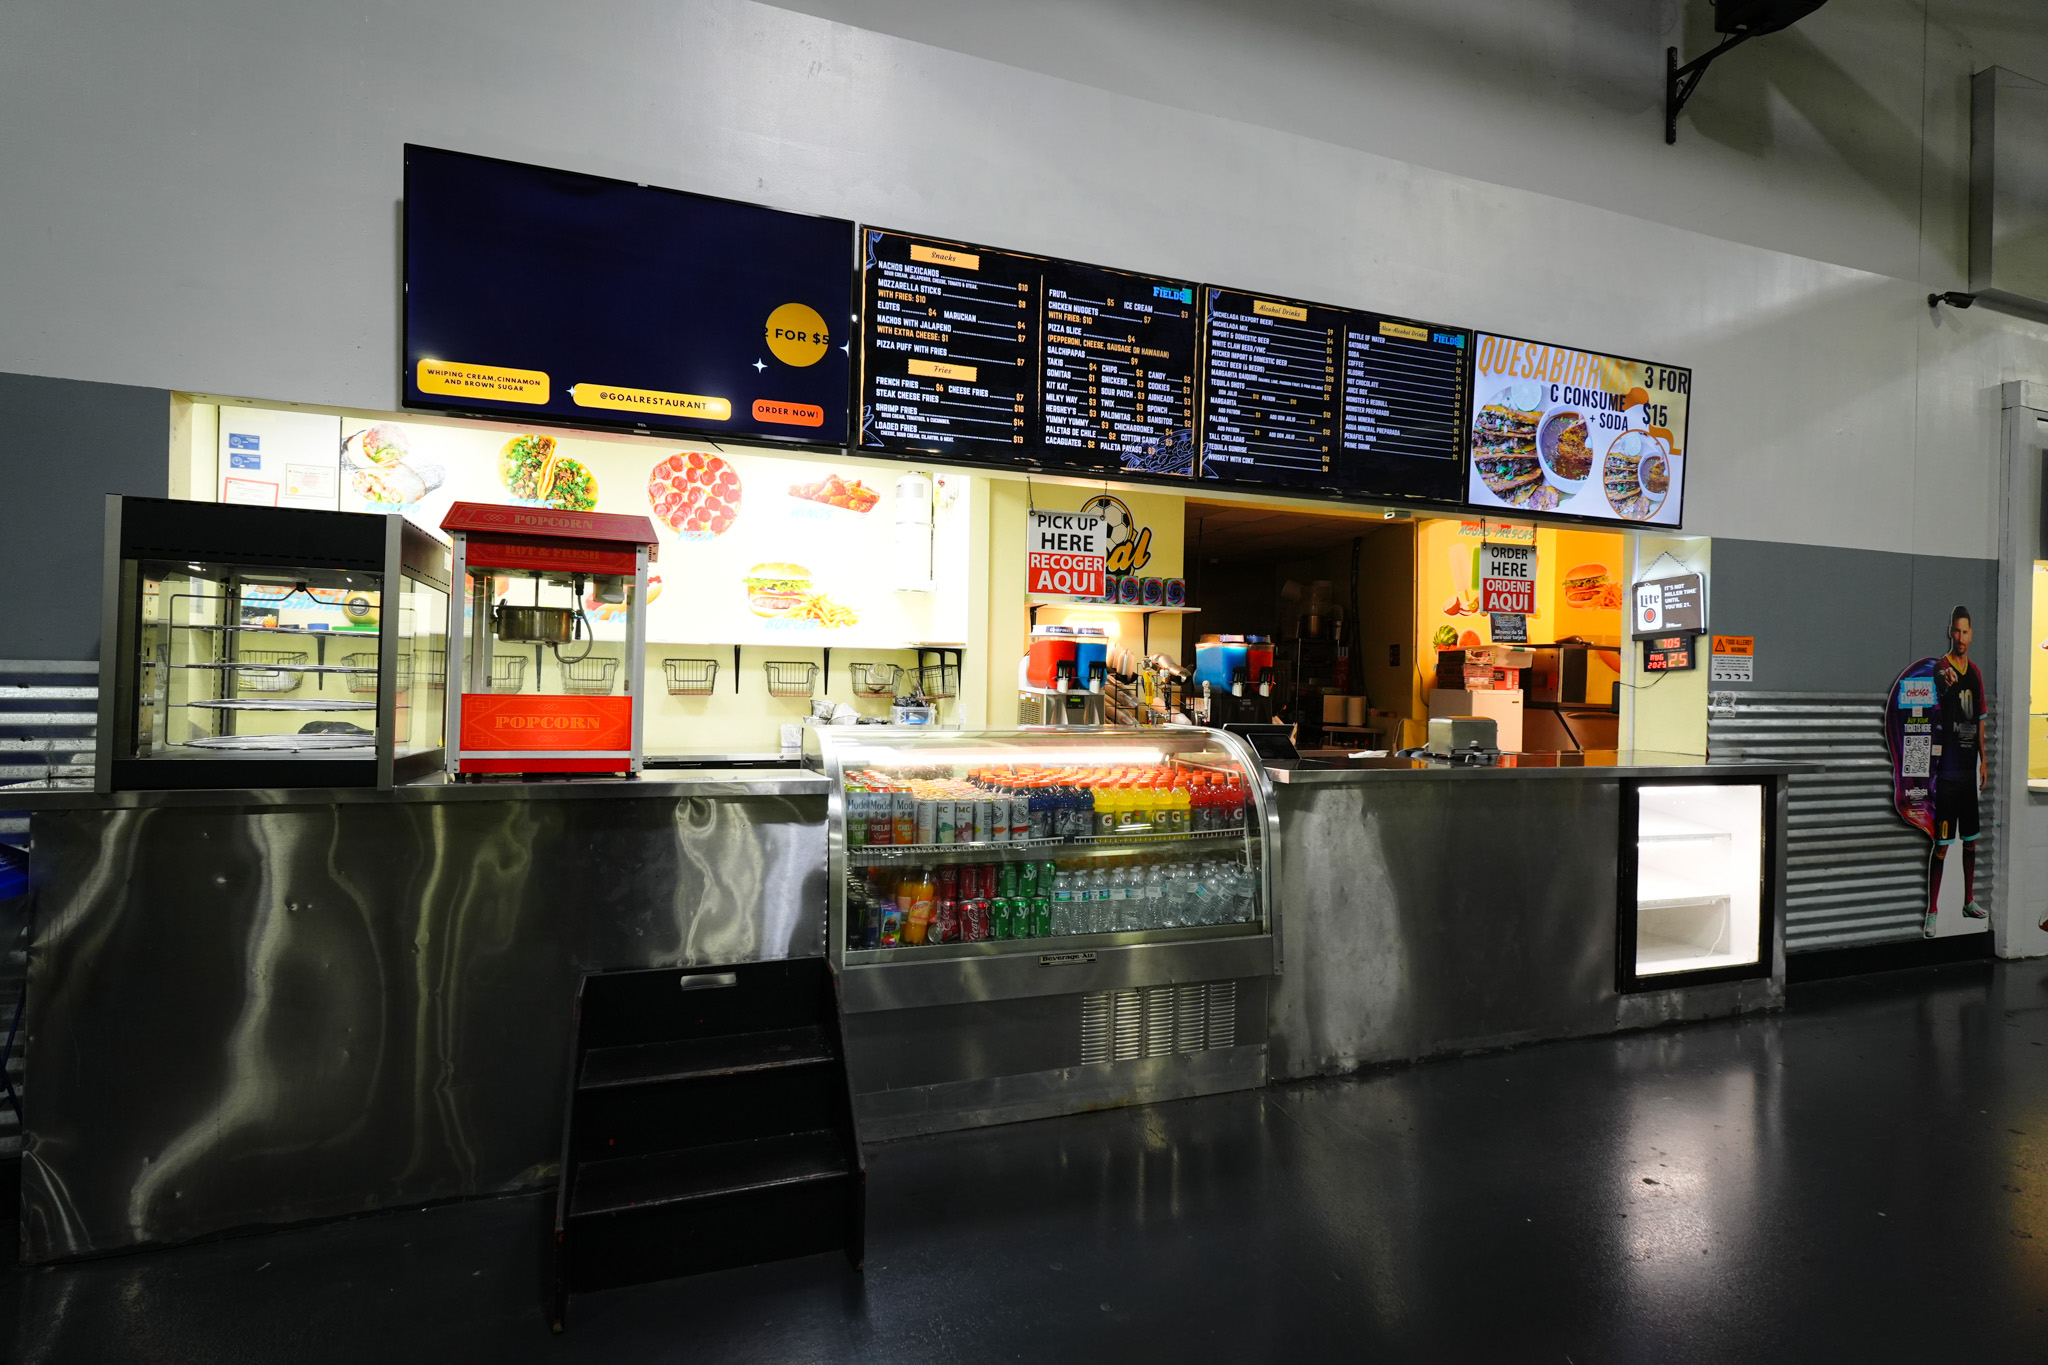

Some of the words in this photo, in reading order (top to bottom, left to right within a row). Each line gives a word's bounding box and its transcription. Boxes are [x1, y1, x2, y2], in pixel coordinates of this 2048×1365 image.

[932, 252, 956, 262] Snacks
[879, 261, 902, 272] NACHOS
[905, 265, 939, 277] MEXICANOS
[1018, 283, 1028, 292] $10
[878, 279, 919, 292] MOZZARELLA
[921, 285, 941, 295] STICKS
[1153, 286, 1186, 301] FIELDS
[878, 289, 893, 299] WITH
[895, 291, 914, 302] FRIES:
[916, 294, 926, 303] $10
[1049, 289, 1067, 299] FRUTA
[1107, 298, 1114, 306] $5
[878, 301, 900, 311] ELOTES
[928, 308, 937, 317] $4
[1049, 301, 1072, 312] CHICKEN
[1074, 305, 1098, 316] NUGGETS
[1144, 316, 1151, 324] $7
[1124, 301, 1133, 310] ICE
[1134, 303, 1153, 313] CREAM
[1259, 305, 1280, 314] Alcohol
[1282, 308, 1300, 318] Drinks
[944, 311, 976, 322] MARUCHAN
[1018, 321, 1025, 329] $4
[877, 315, 901, 325] NACHOS
[903, 318, 918, 328] WITH
[920, 321, 951, 332] JALAPENO
[1018, 335, 1025, 343] $7
[877, 325, 892, 335] WITH
[894, 328, 914, 338] EXTRA
[916, 330, 940, 341] CHEESE:
[942, 333, 948, 342] $1
[1048, 324, 1064, 333] PIZZA
[1066, 326, 1082, 336] SLICE
[1128, 335, 1135, 343] $4
[776, 329, 806, 342] FOR
[813, 333, 829, 345] $5
[1434, 333, 1459, 345] FIELDS
[877, 339, 895, 350] PIZZA
[897, 342, 912, 351] PUFF
[914, 344, 929, 354] WITH
[930, 346, 947, 356] FRIES
[1017, 358, 1025, 366] $7
[1048, 346, 1085, 358] SALCHIPAPAS
[934, 365, 952, 374] Fries
[1047, 357, 1063, 367] TAKIS
[1102, 364, 1117, 374] CHIPS
[1478, 336, 1636, 394] QUESABIRRIAS
[427, 369, 463, 377] WHIPING
[1148, 371, 1166, 381] CANDY
[1645, 367, 1653, 388] 3
[1659, 370, 1688, 394] FOR
[876, 376, 899, 387] FRENCH
[901, 379, 918, 389] FRIES
[936, 384, 944, 392] $6
[1101, 376, 1127, 386] SNICKERS
[1148, 382, 1170, 392] COOKIES
[948, 385, 970, 395] CHEESE
[972, 388, 988, 397] FRIES
[1551, 384, 1558, 403] C
[1564, 386, 1627, 413] CONSUME
[600, 392, 706, 409] @GOALRESTAURANT
[876, 389, 895, 398] STEAK
[898, 391, 920, 401] CHEESE
[922, 393, 939, 403] FRIES
[1014, 404, 1024, 413] $10
[1148, 394, 1174, 404] AIRHEADS
[758, 406, 788, 415] ORDER
[793, 410, 818, 418] NOW!
[876, 403, 899, 413] SHRIMP
[900, 405, 917, 415] FRIES
[1014, 418, 1024, 427] $14
[1046, 405, 1076, 415] HERSHEY'S
[1643, 402, 1667, 427] $15
[1046, 415, 1067, 425] YUMMY
[1068, 417, 1089, 427] YUMMY
[1600, 412, 1628, 431] SODA
[875, 421, 898, 431] LOADED
[900, 423, 917, 433] FRIES
[1013, 436, 1023, 444] $13
[1242, 457, 1254, 465] COKE
[514, 514, 593, 530] POPCORN
[1038, 515, 1073, 530] PICK
[1078, 517, 1098, 531] UP
[677, 530, 715, 542] PIZZA
[1459, 525, 1492, 537] AGUAS
[1495, 527, 1535, 540] FRESCAS
[1041, 533, 1094, 552] HERE
[505, 545, 533, 556] HOT
[553, 547, 599, 560] FRESH
[1491, 547, 1528, 559] ORDER
[1031, 554, 1103, 571] RECOGER
[1492, 562, 1527, 577] HERE
[1037, 571, 1095, 594] AQUI
[1487, 580, 1531, 593] ORDENE
[1488, 594, 1529, 611] AQUI
[1640, 594, 1659, 607] Lite
[765, 618, 820, 630] BURGER
[1668, 652, 1688, 667] 25
[1907, 689, 1929, 697] CHICAGO
[1959, 689, 1973, 719] 10
[495, 716, 600, 729] POPCORN
[1102, 814, 1113, 826] G
[1121, 813, 1131, 825] G
[1156, 811, 1166, 823] G
[1172, 811, 1181, 822] G
[1234, 808, 1243, 820] G
